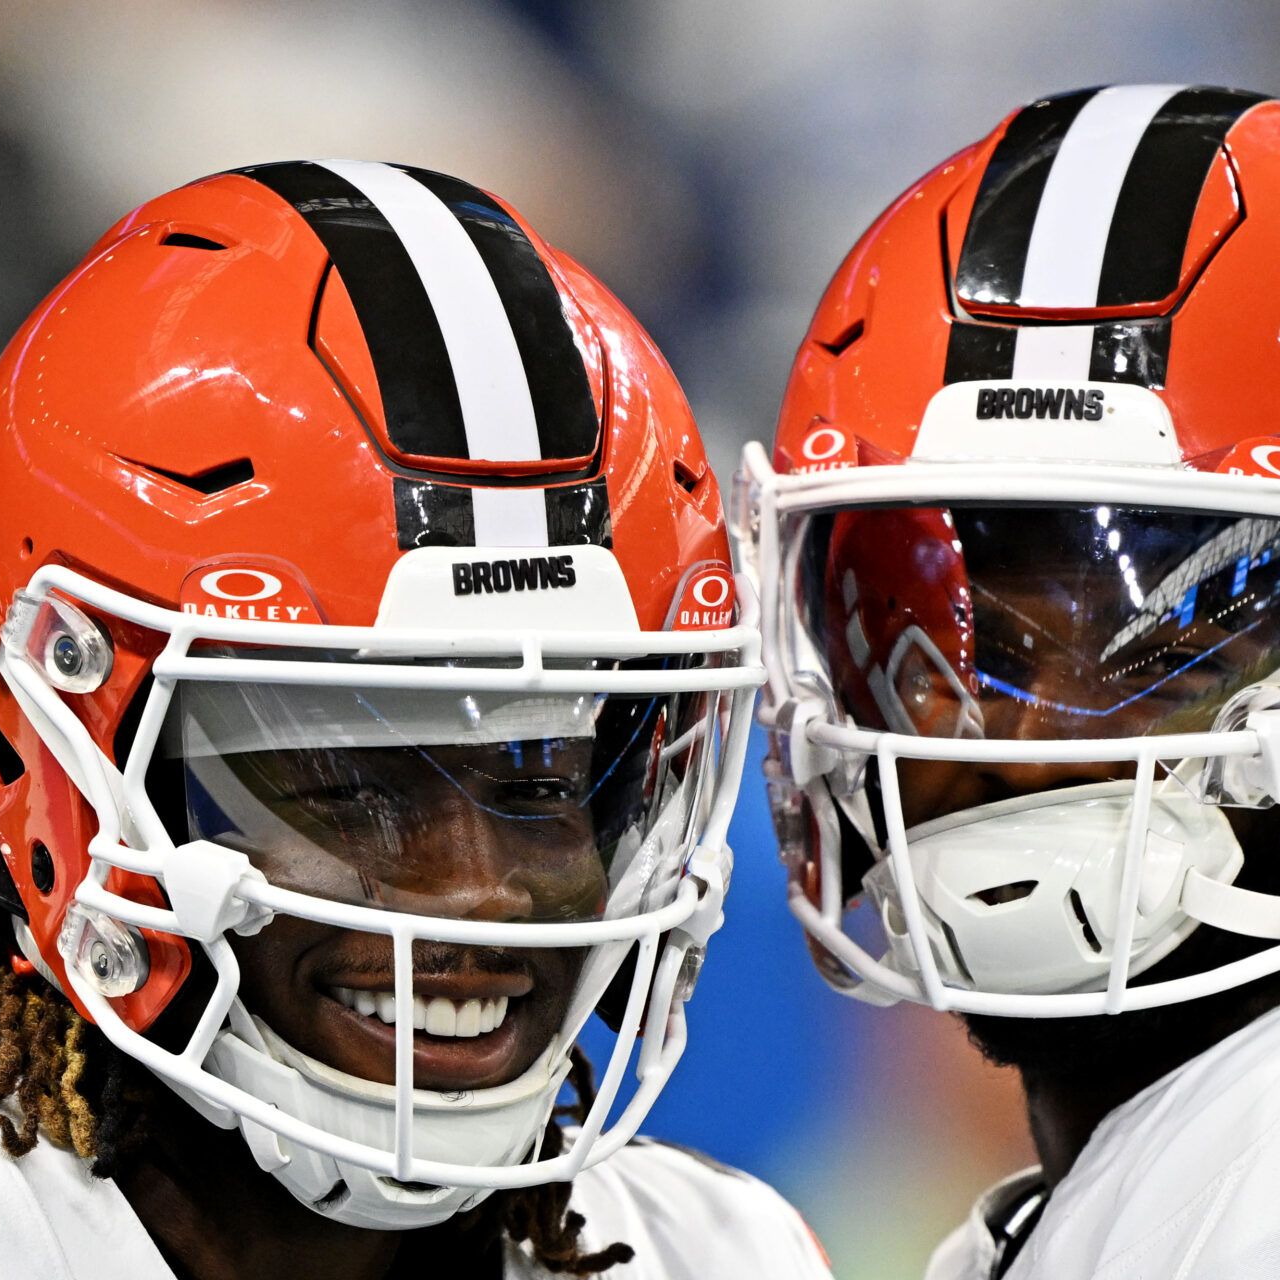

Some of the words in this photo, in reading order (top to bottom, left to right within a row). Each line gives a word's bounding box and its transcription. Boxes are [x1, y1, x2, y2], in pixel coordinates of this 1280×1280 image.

[976, 387, 1105, 421] BROWNS
[452, 554, 577, 597] BROWNS
[680, 610, 732, 625] OAKLEY
